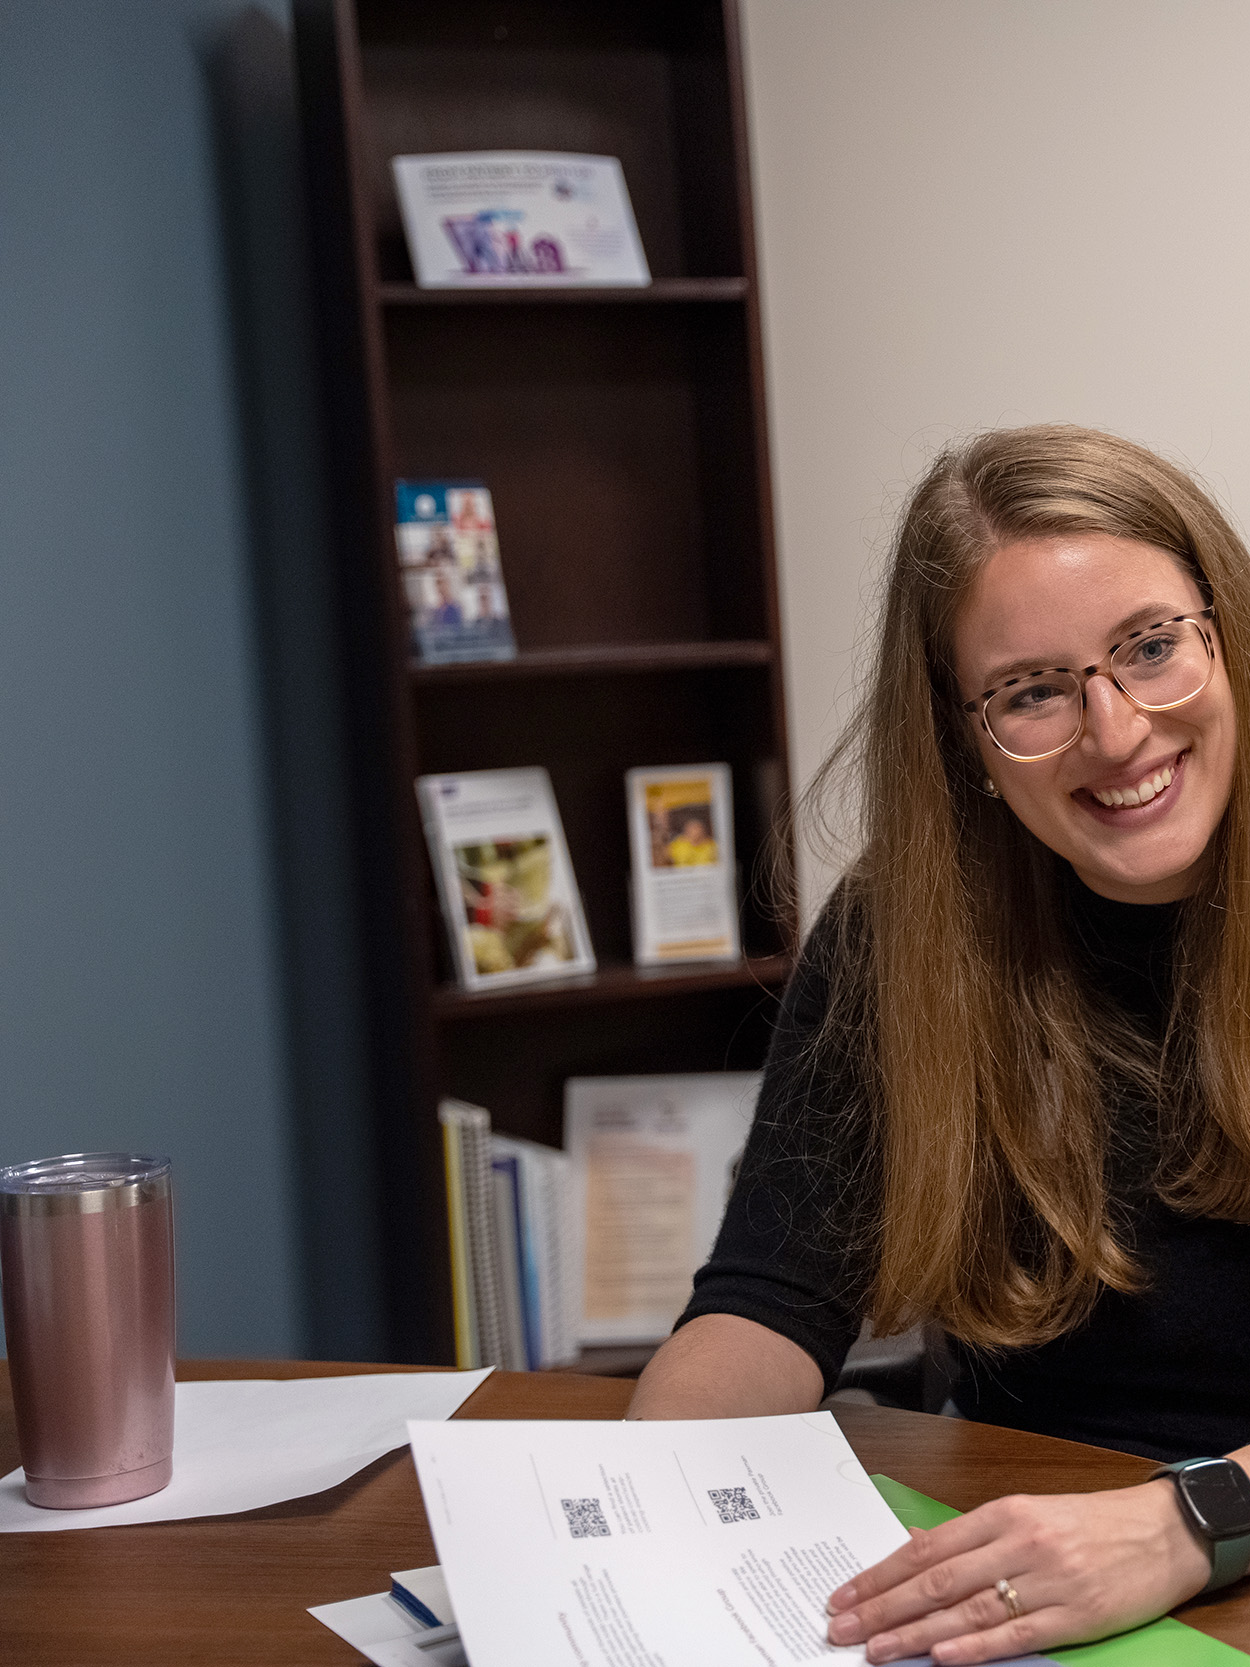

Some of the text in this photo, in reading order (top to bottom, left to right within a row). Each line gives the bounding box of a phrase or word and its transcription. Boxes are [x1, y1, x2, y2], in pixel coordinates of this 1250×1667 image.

[751, 1477, 765, 1495] private
[756, 1473, 783, 1515] Facebook Group
[715, 1588, 776, 1667] axman Facebook Group
